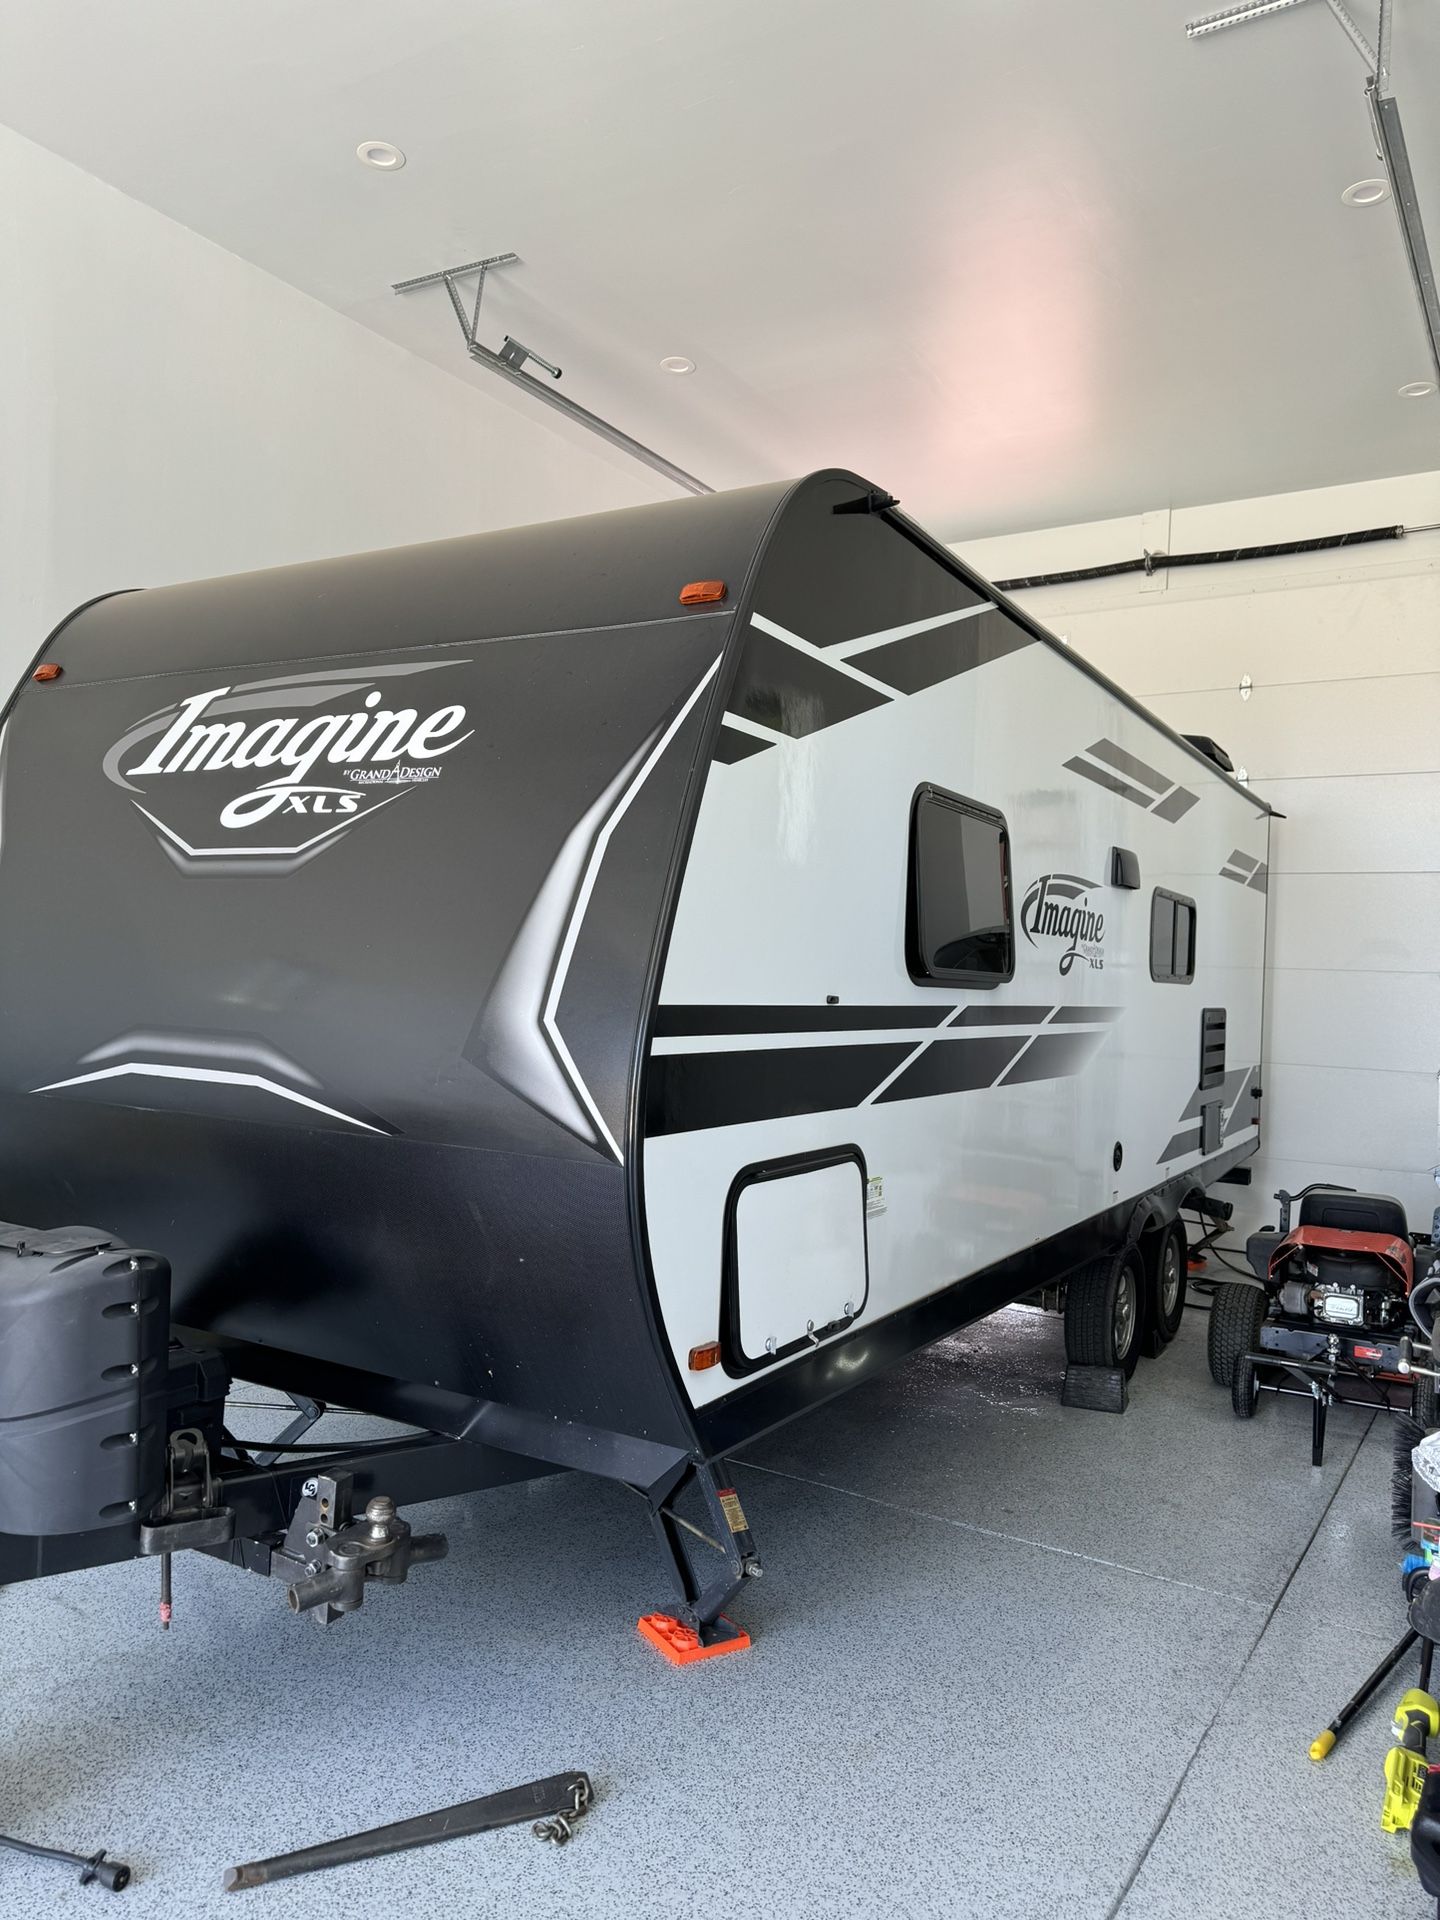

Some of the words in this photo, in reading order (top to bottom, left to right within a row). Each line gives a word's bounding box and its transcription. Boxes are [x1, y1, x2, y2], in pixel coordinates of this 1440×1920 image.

[126, 686, 475, 829] Imagine
[350, 768, 391, 781] GRAND
[400, 767, 442, 778] DESIGN
[282, 794, 361, 813] XLS
[1029, 874, 1105, 976] Imagine
[1089, 958, 1103, 969] XLS
